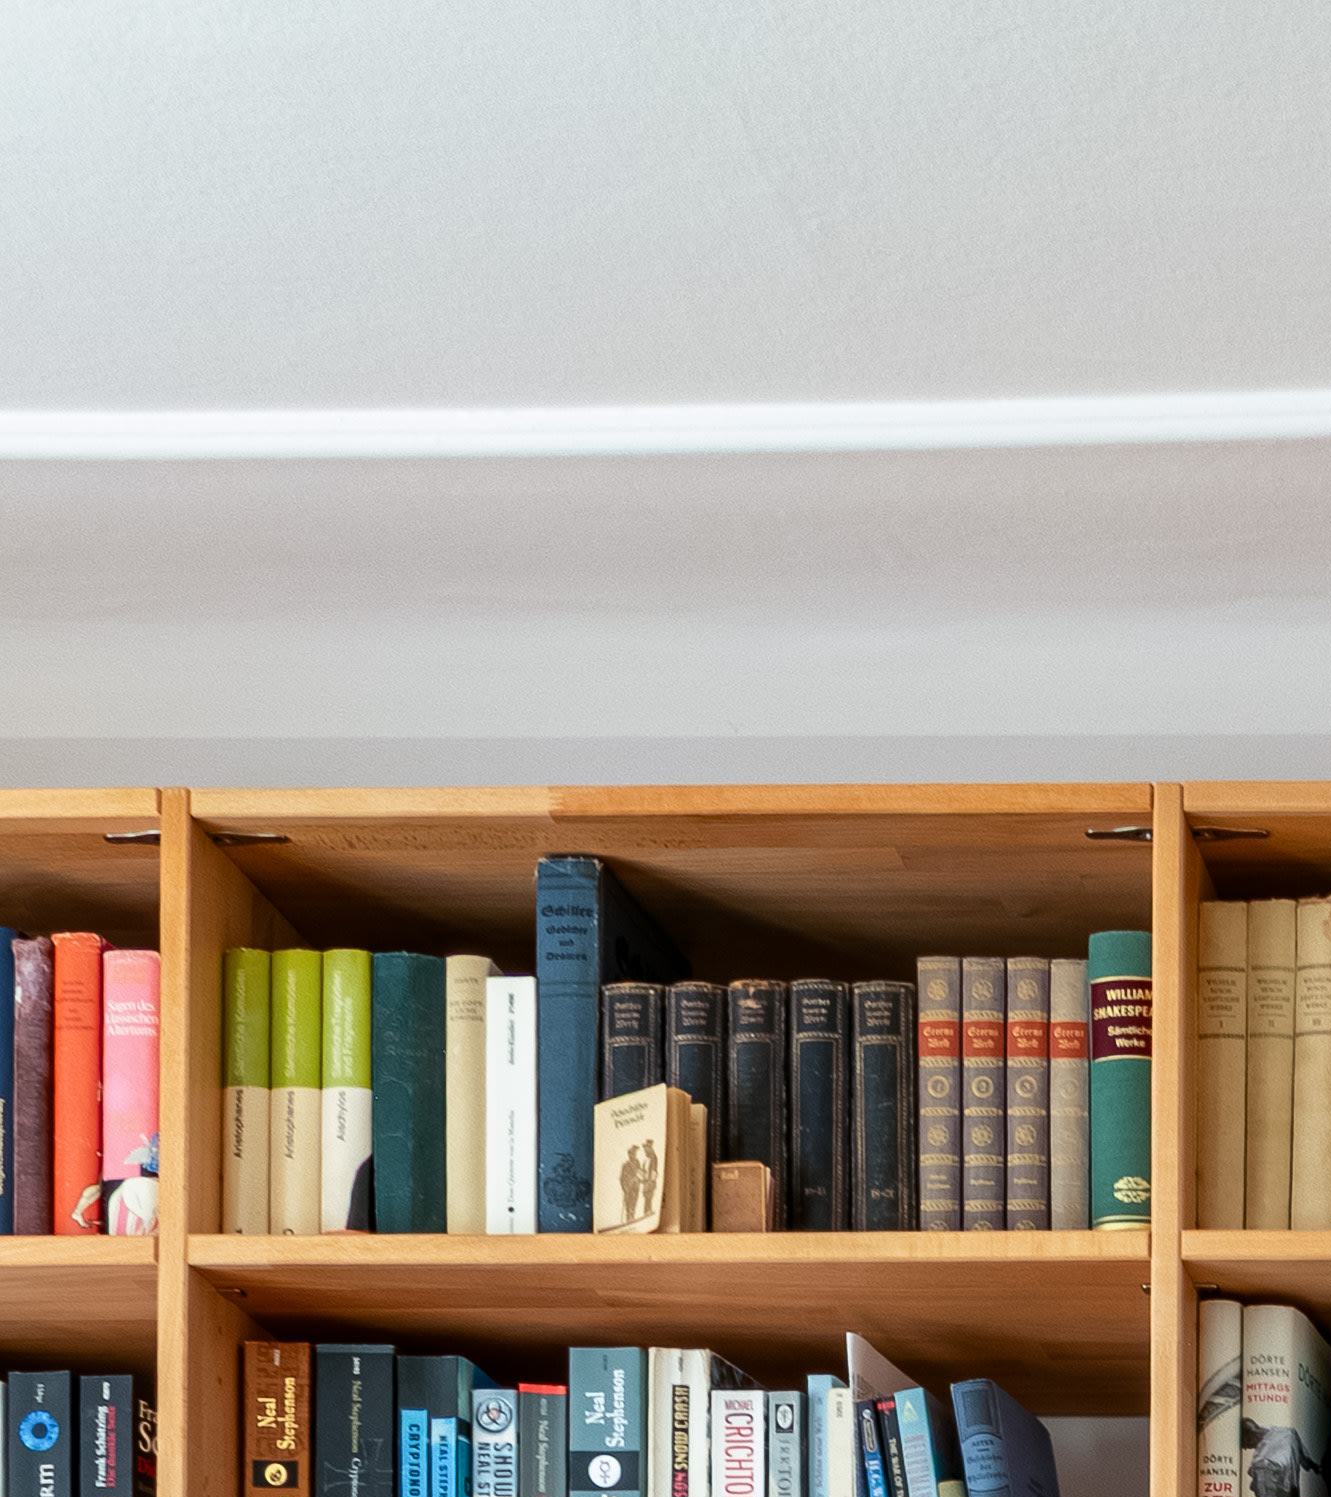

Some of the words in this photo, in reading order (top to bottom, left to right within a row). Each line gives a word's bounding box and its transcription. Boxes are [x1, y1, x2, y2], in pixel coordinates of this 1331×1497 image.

[541, 905, 595, 918] Schiller
[1116, 1038, 1145, 1048] Werke
[234, 1089, 244, 1159] Aristophanes
[284, 1091, 295, 1159] Aristophanes
[336, 1091, 347, 1141] Aischylos
[1246, 1367, 1289, 1378] HANSEN
[1250, 1355, 1285, 1365] DÖRTE
[1246, 1382, 1290, 1392] MITTAGS
[1247, 1394, 1288, 1403] STUNDE
[257, 1398, 276, 1427] Neal
[278, 1377, 298, 1449] Stephenson
[585, 1392, 605, 1424] Neal
[606, 1369, 628, 1447] Stephenson
[674, 1386, 688, 1428] CRASH
[96, 1406, 107, 1456] Schätzing
[439, 1435, 447, 1461] NEAL
[478, 1442, 490, 1475] NEAL
[674, 1431, 688, 1470] SNOW
[889, 1438, 897, 1455] THE
[1203, 1454, 1232, 1464] DÖRTE
[96, 1459, 106, 1487] Frank
[891, 1457, 900, 1472] WAR
[1200, 1467, 1237, 1477] HANSEN
[894, 1476, 902, 1486] OF
[1204, 1483, 1232, 1493] ZUR
